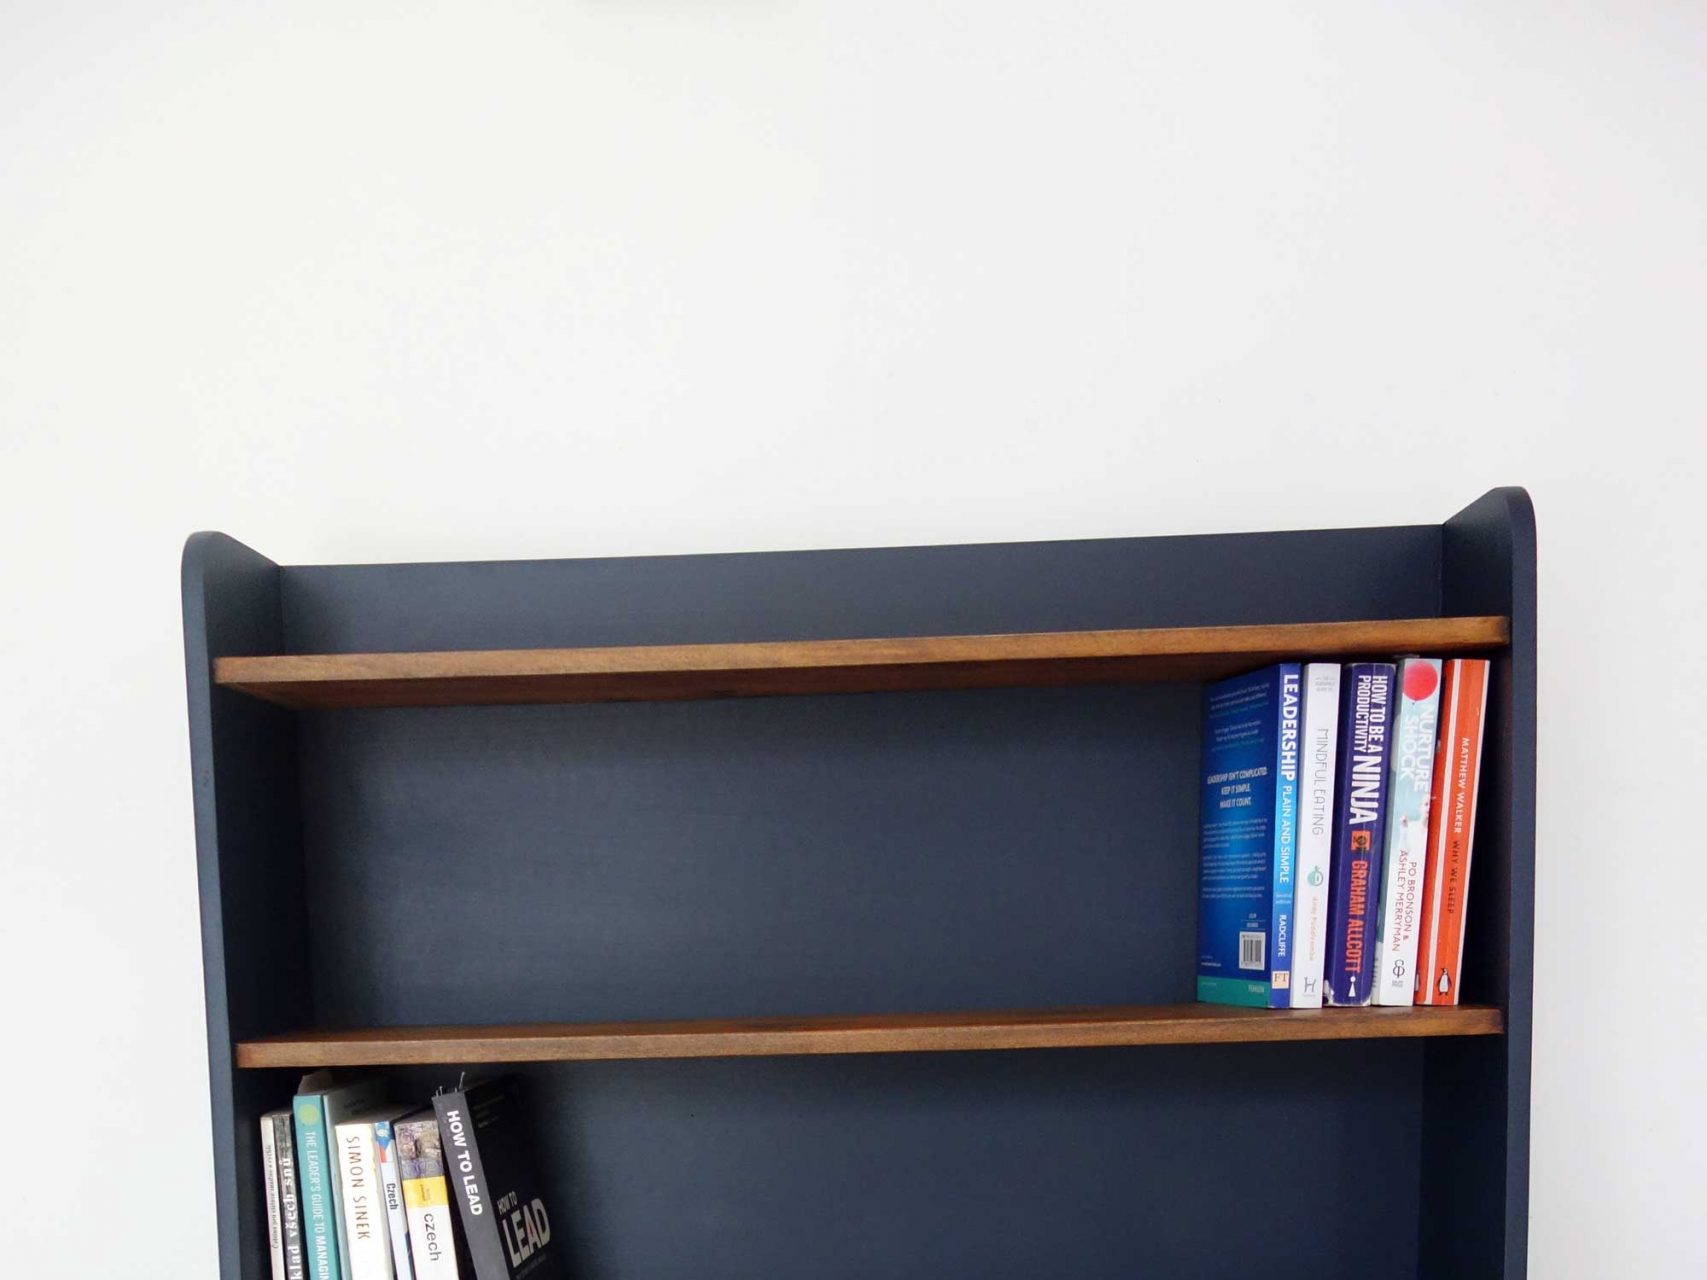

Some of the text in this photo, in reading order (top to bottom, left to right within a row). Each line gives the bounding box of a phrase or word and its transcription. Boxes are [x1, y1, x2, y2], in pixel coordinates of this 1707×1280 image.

[1280, 674, 1299, 782] LEADERSHIP
[1354, 674, 1371, 753] PRODUCTIVITY
[1367, 675, 1388, 754] HOW TO BE A
[1400, 714, 1418, 780] SHOCK
[1413, 703, 1435, 792] NURTURE
[1281, 785, 1293, 818] PLAIN
[1312, 728, 1329, 836] MINDFUL EATING
[1349, 755, 1382, 825] NINJA
[1454, 737, 1471, 834] MATTHEW WALKER
[1280, 820, 1291, 845] AND
[1279, 846, 1290, 884] SIMPLE
[1408, 861, 1417, 876] PO
[1447, 840, 1460, 914] WHY WE SLEEP
[1345, 860, 1368, 973] GRAHAM ALLCOTT
[1392, 850, 1408, 952] ASHLEY MERRYMAN
[1403, 879, 1416, 933] BRONSON
[1274, 973, 1288, 982] FT
[305, 1131, 316, 1148] THE
[447, 1110, 483, 1216] HOW TO LEAD
[279, 1157, 292, 1186] snů
[307, 1150, 321, 1193] LEADER'S
[346, 1136, 370, 1240] SIMON SINEK
[386, 1183, 399, 1210] Czech
[283, 1194, 299, 1238] všech
[312, 1194, 323, 1223] GUIDE
[314, 1224, 324, 1234] TO
[424, 1213, 442, 1261] czech
[502, 1198, 550, 1268] LEAD
